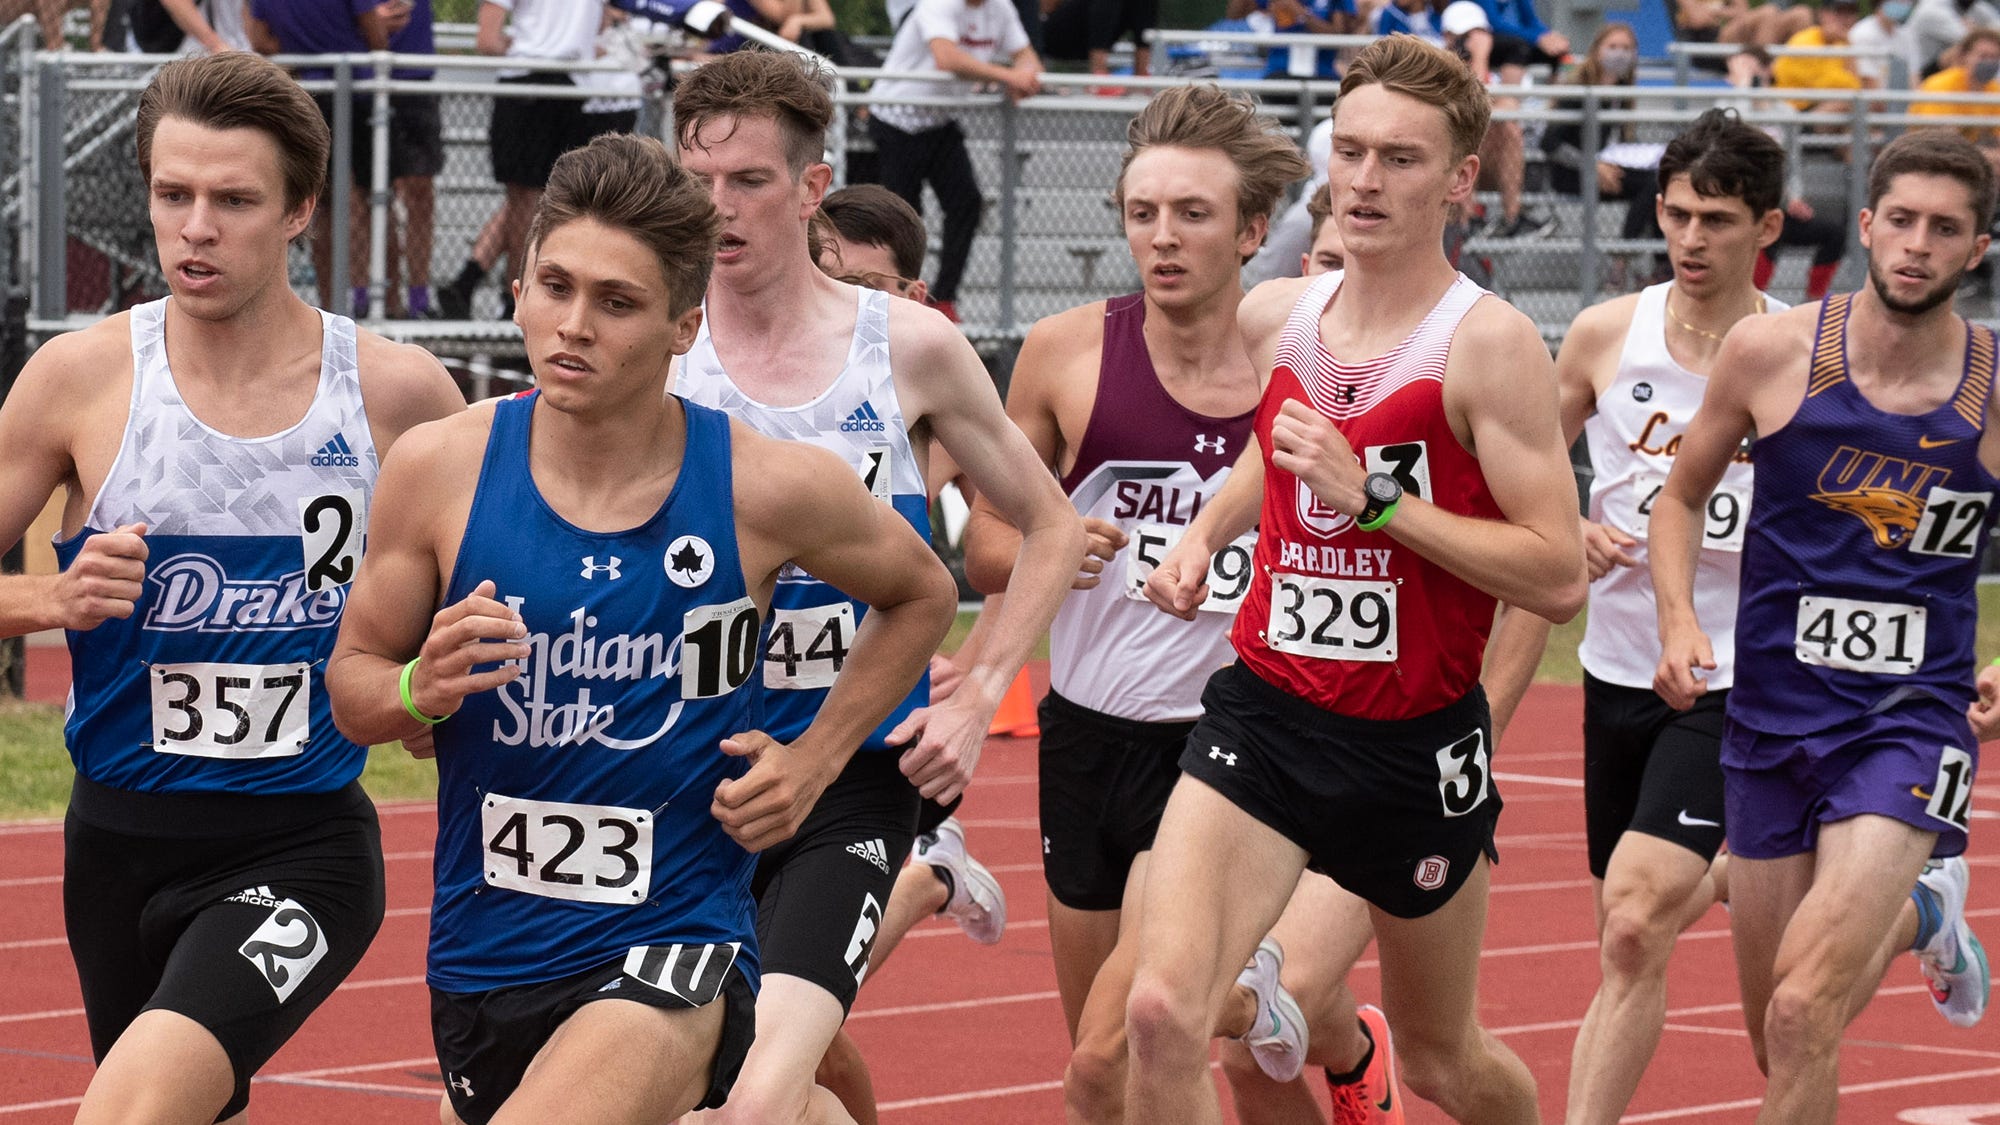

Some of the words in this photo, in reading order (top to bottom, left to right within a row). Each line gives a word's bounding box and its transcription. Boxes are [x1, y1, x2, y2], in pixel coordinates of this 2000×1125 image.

[841, 420, 885, 432] adidas
[311, 453, 359, 467] adidas
[1817, 445, 1952, 499] UNI
[304, 495, 353, 592] 2
[1280, 538, 1392, 577] BRADLEY
[1922, 500, 1987, 554] 12
[144, 554, 345, 631] Drake
[1136, 535, 1250, 600] 59
[1277, 582, 1391, 649] 329
[1802, 609, 1914, 663] 481
[684, 608, 760, 697] 10
[162, 672, 304, 745] 357
[493, 668, 685, 750] State
[1444, 733, 1482, 813] 3
[489, 812, 639, 888] 423
[846, 845, 890, 875] adidas
[243, 908, 318, 988] 2
